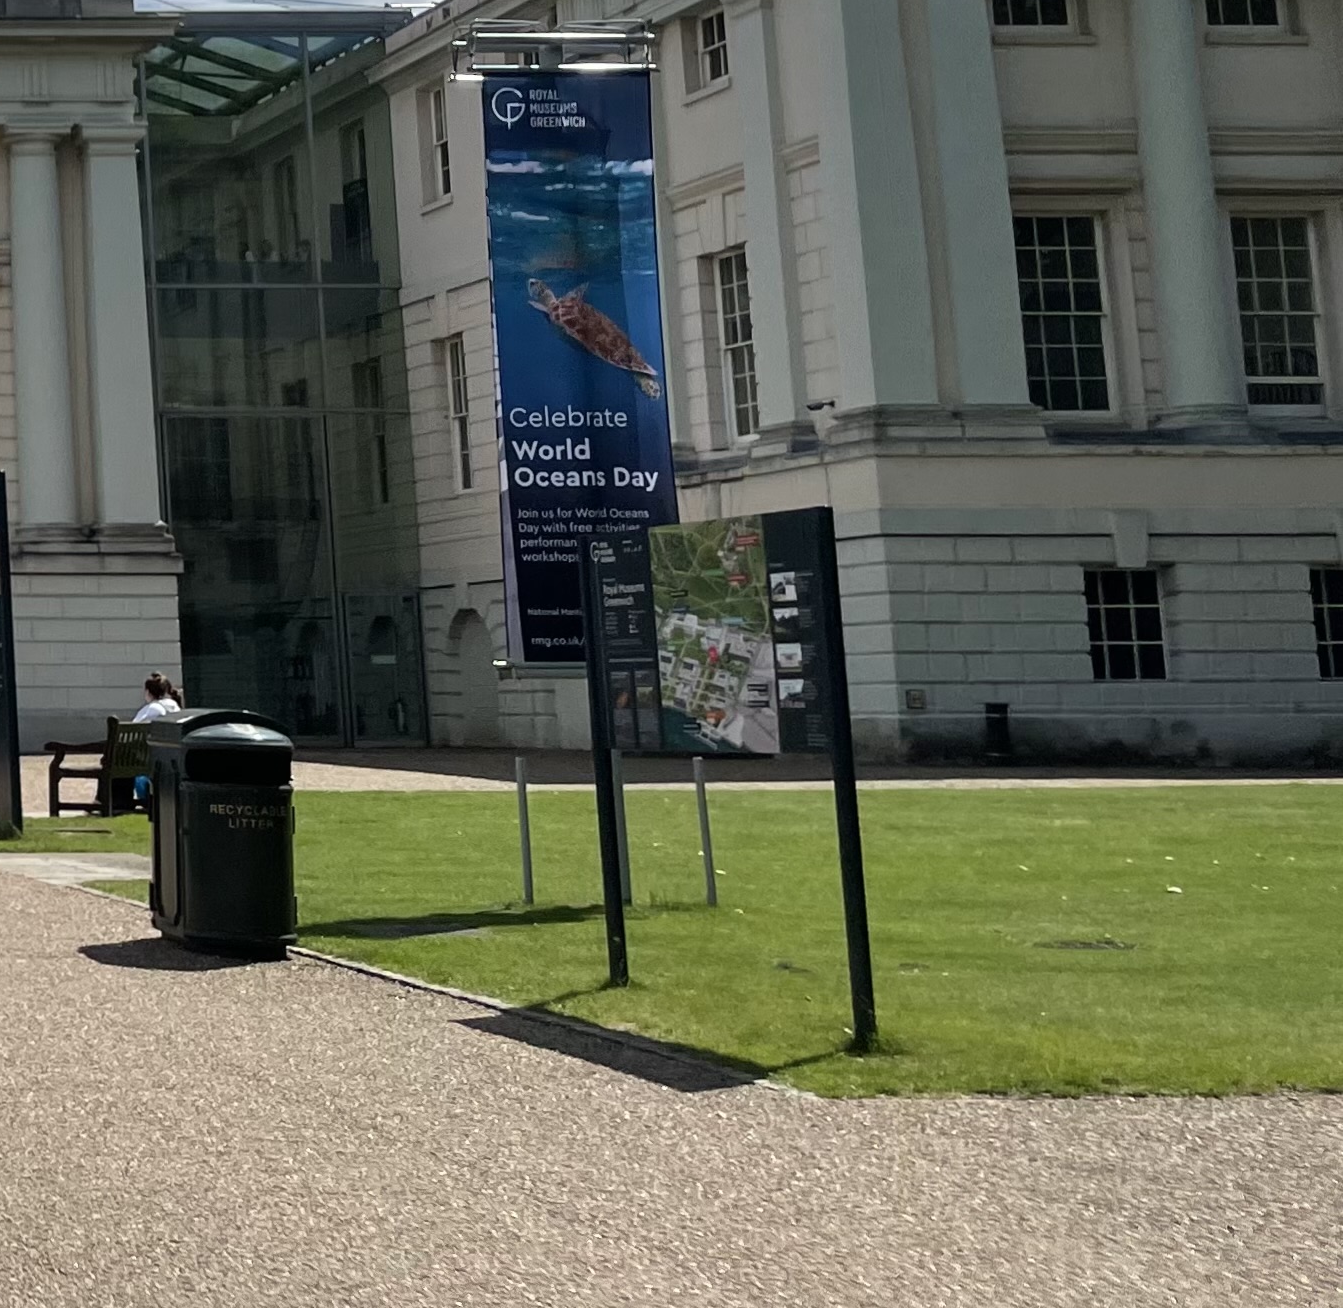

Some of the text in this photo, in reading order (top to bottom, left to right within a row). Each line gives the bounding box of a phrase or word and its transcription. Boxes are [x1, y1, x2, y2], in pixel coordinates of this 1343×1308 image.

[529, 89, 560, 101] ROYAL
[529, 102, 578, 114] MUSEUMS
[530, 116, 586, 128] GREENWICH
[509, 404, 628, 428] Celebrate
[511, 437, 591, 461] World
[514, 466, 659, 492] Oceans Day
[517, 507, 650, 519] Join us for World Oceans
[518, 522, 540, 534] Day
[541, 522, 567, 532] with
[569, 522, 593, 532] free
[520, 536, 577, 549] performan
[209, 804, 287, 816] RECYCLABLE
[228, 817, 274, 829] LITTER
